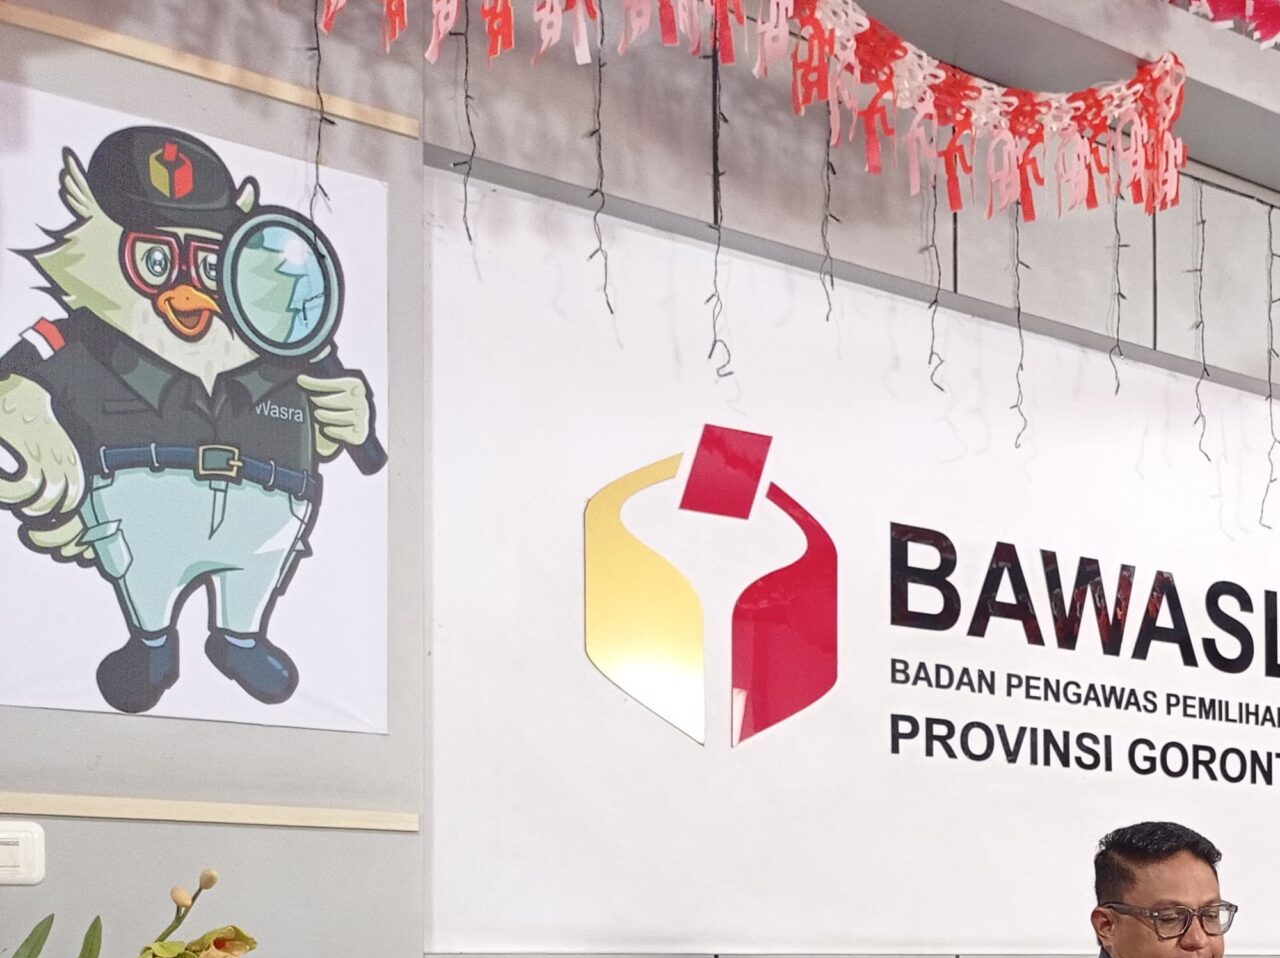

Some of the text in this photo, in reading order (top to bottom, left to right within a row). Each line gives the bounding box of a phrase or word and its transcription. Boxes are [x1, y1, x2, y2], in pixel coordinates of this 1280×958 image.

[256, 400, 303, 422] Wasra
[890, 658, 996, 695] BADAN
[1006, 673, 1158, 714] PENGAWAS
[890, 713, 1113, 772] PROVINSI
